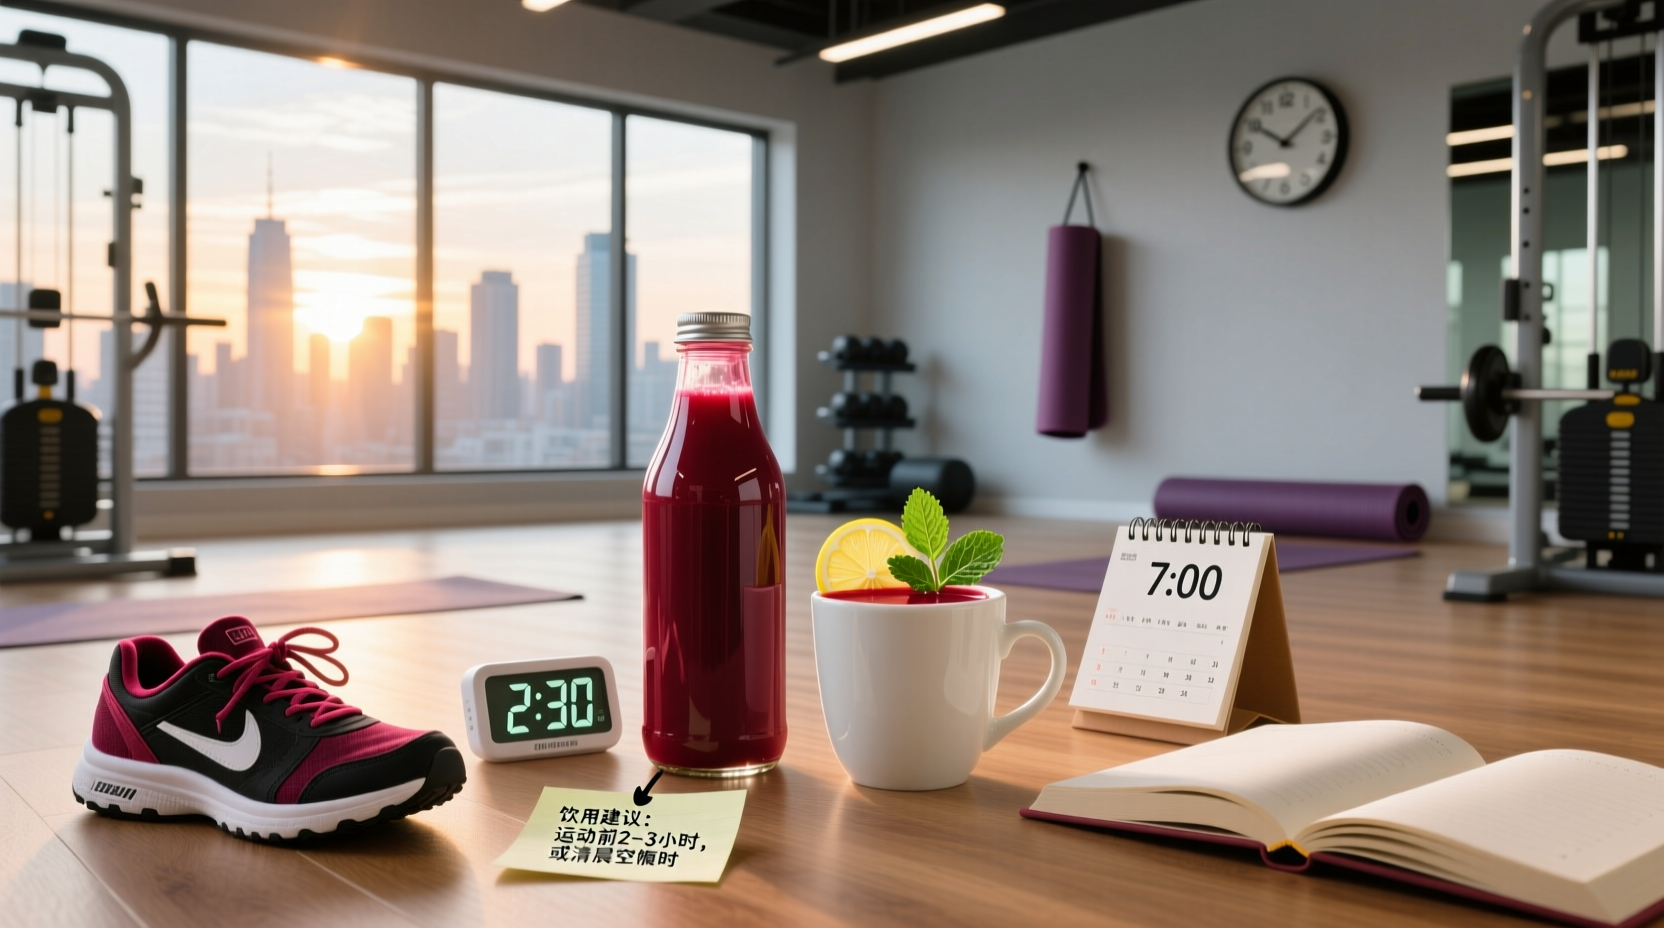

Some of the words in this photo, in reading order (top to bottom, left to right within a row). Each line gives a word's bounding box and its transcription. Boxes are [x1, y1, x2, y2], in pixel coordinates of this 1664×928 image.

[1279, 92, 1295, 107] 12
[1261, 101, 1273, 115] 11
[1321, 130, 1333, 145] 3
[1242, 140, 1253, 156] 9
[1280, 181, 1291, 196] 6
[1147, 561, 1223, 600] 7:00
[507, 677, 593, 734] 2:30
[559, 806, 651, 827] 饮用建议：
[554, 826, 707, 852] 运动前2-3小时，
